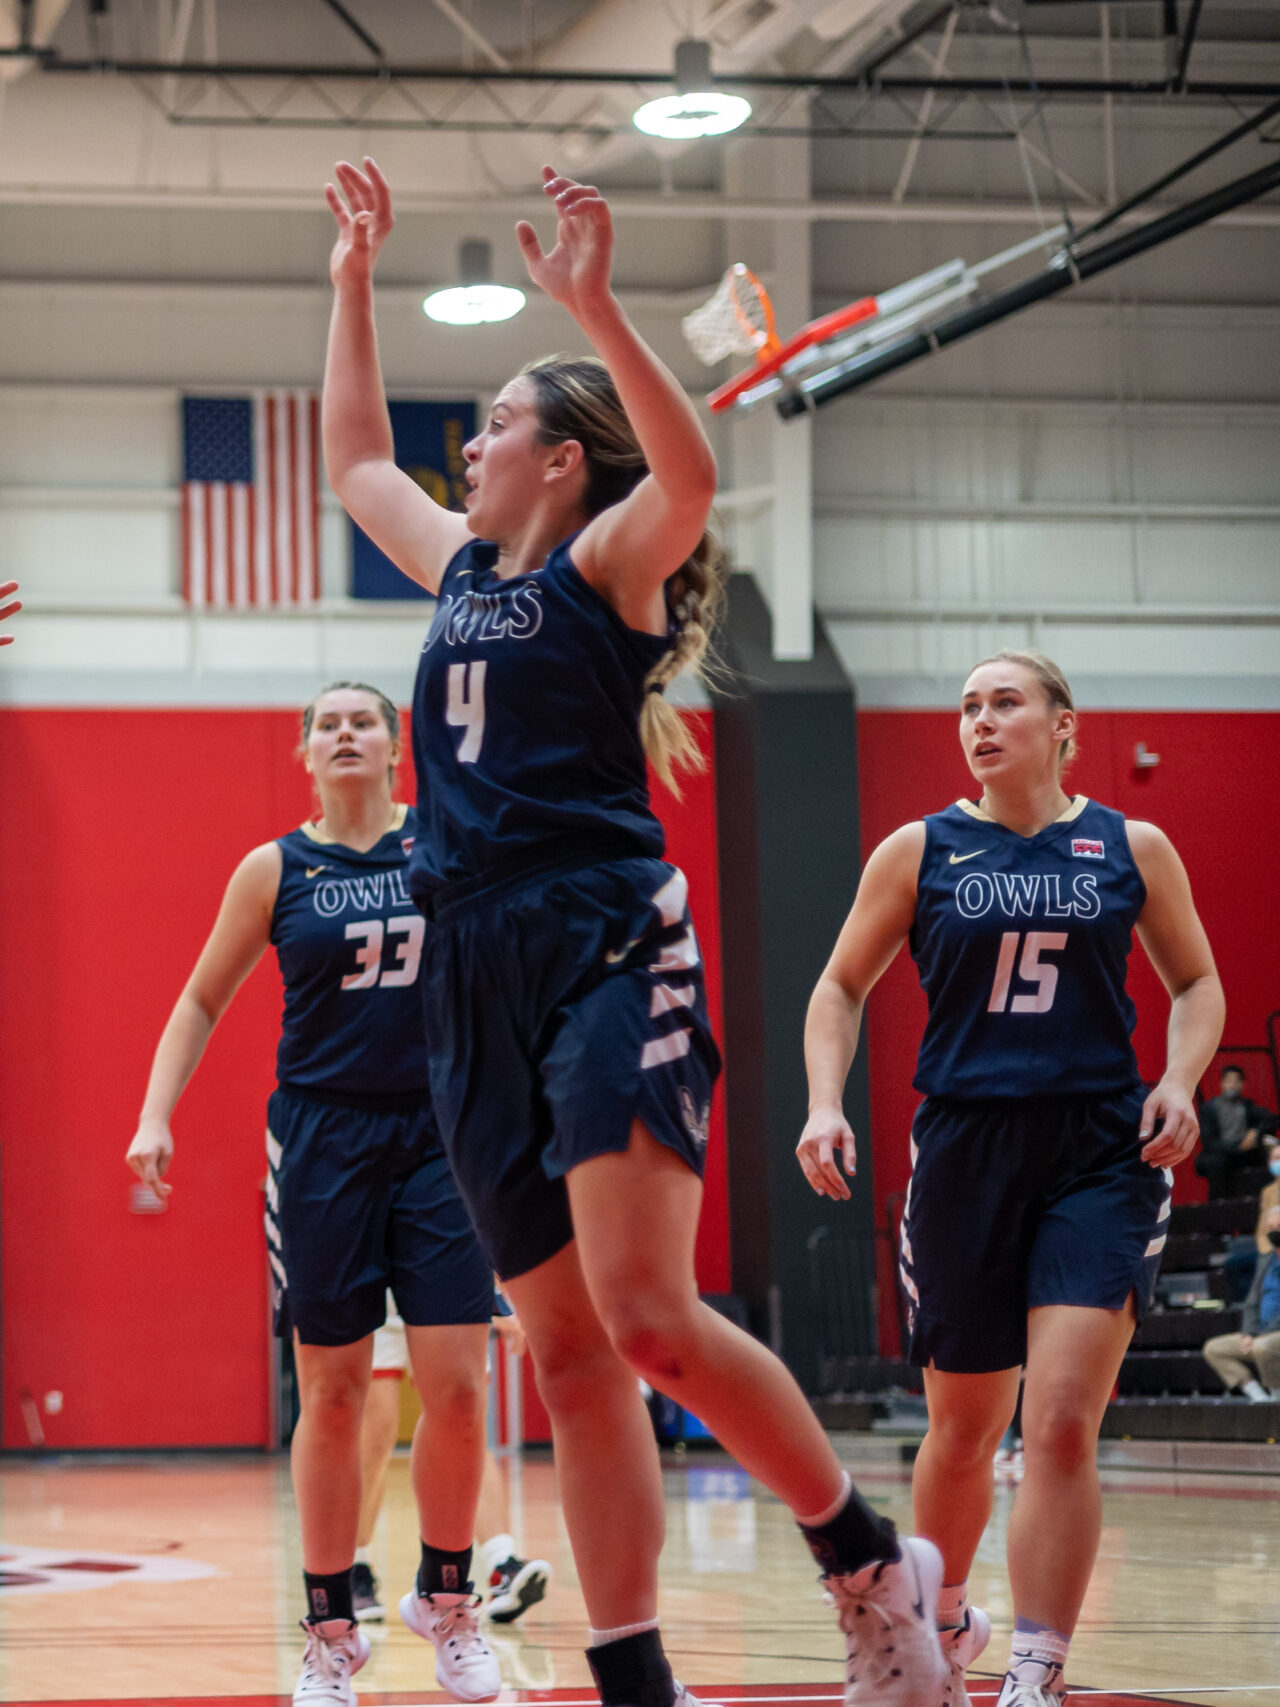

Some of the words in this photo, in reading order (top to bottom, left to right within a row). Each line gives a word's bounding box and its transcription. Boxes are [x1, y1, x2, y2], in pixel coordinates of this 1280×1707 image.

[446, 660, 487, 763] 4
[314, 869, 413, 918] OWL
[955, 872, 1101, 919] OWLS
[340, 914, 426, 991] 33
[987, 931, 1069, 1014] 15
